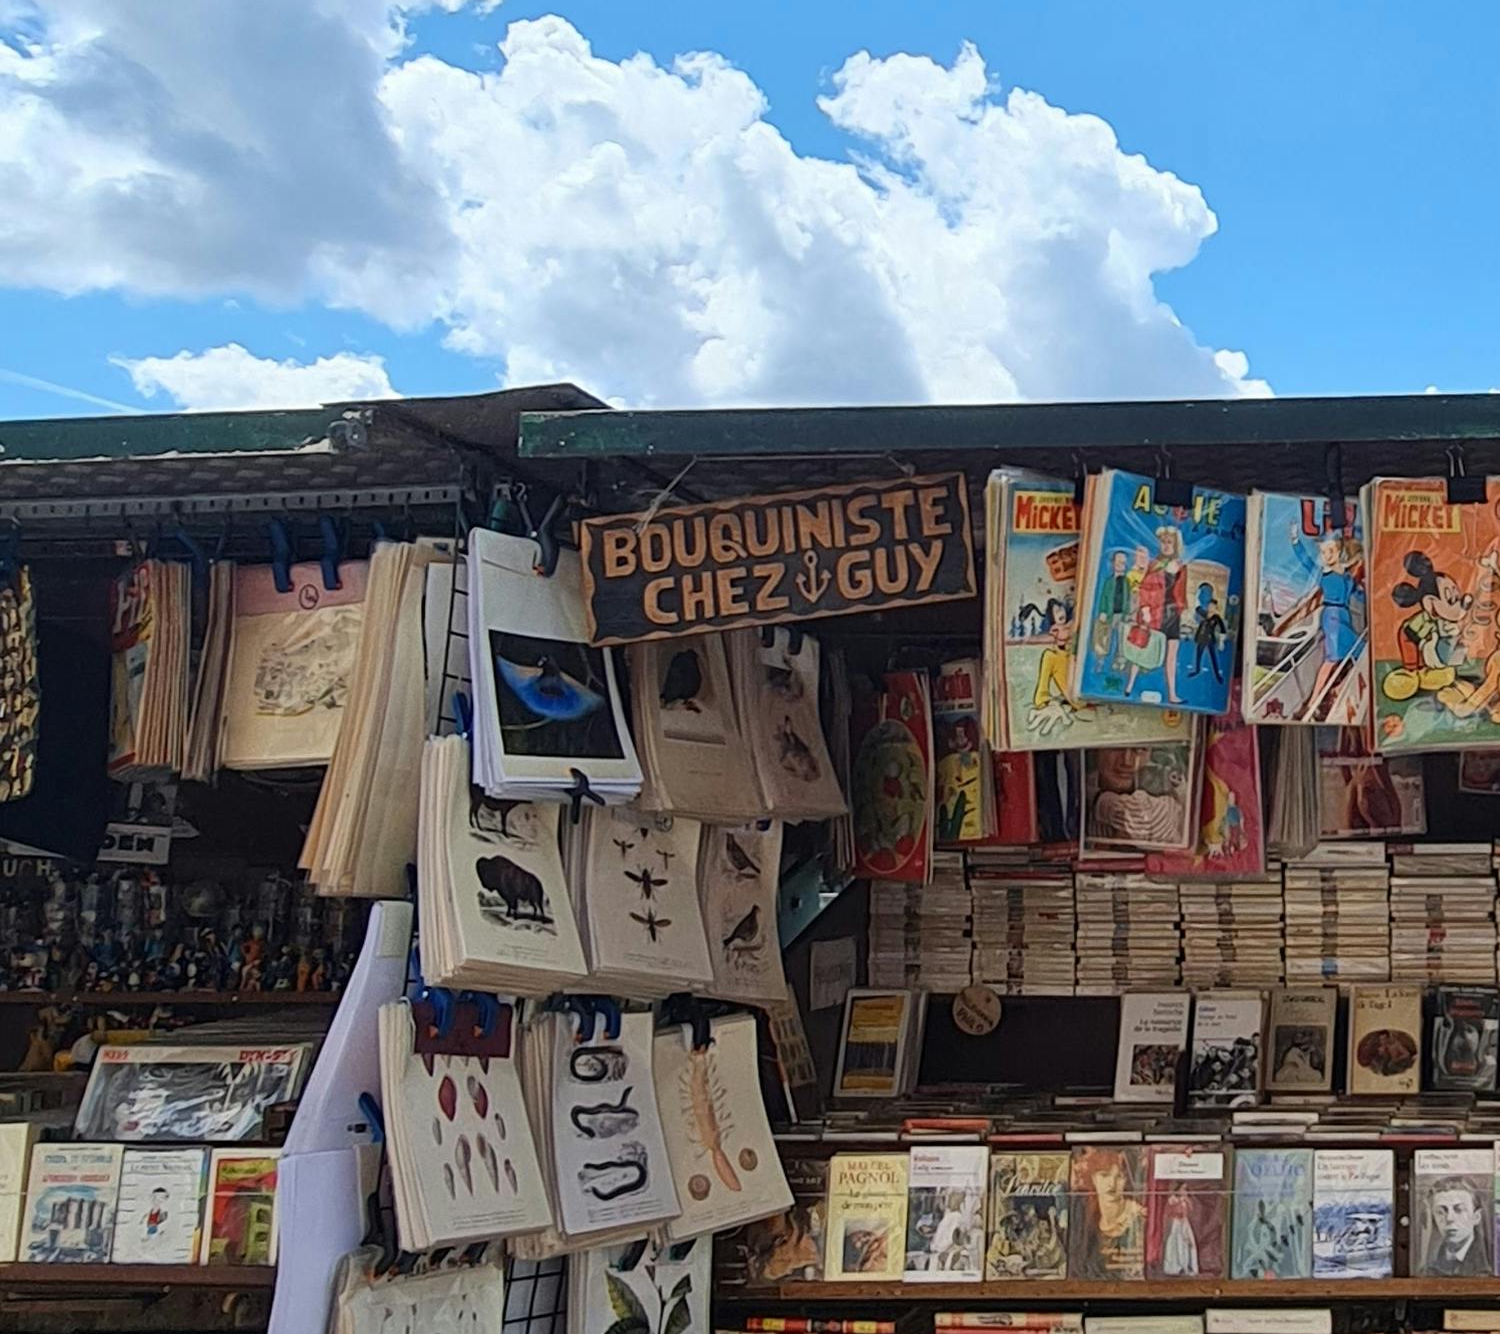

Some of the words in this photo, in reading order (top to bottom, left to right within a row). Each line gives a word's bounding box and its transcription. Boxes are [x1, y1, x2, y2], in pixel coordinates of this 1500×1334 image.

[603, 485, 953, 579] BOUQUINISTE
[1383, 494, 1455, 531] MICKEY
[643, 563, 790, 625] CHEZ
[836, 539, 944, 601] GUY
[838, 1170, 900, 1185] PAGNOL
